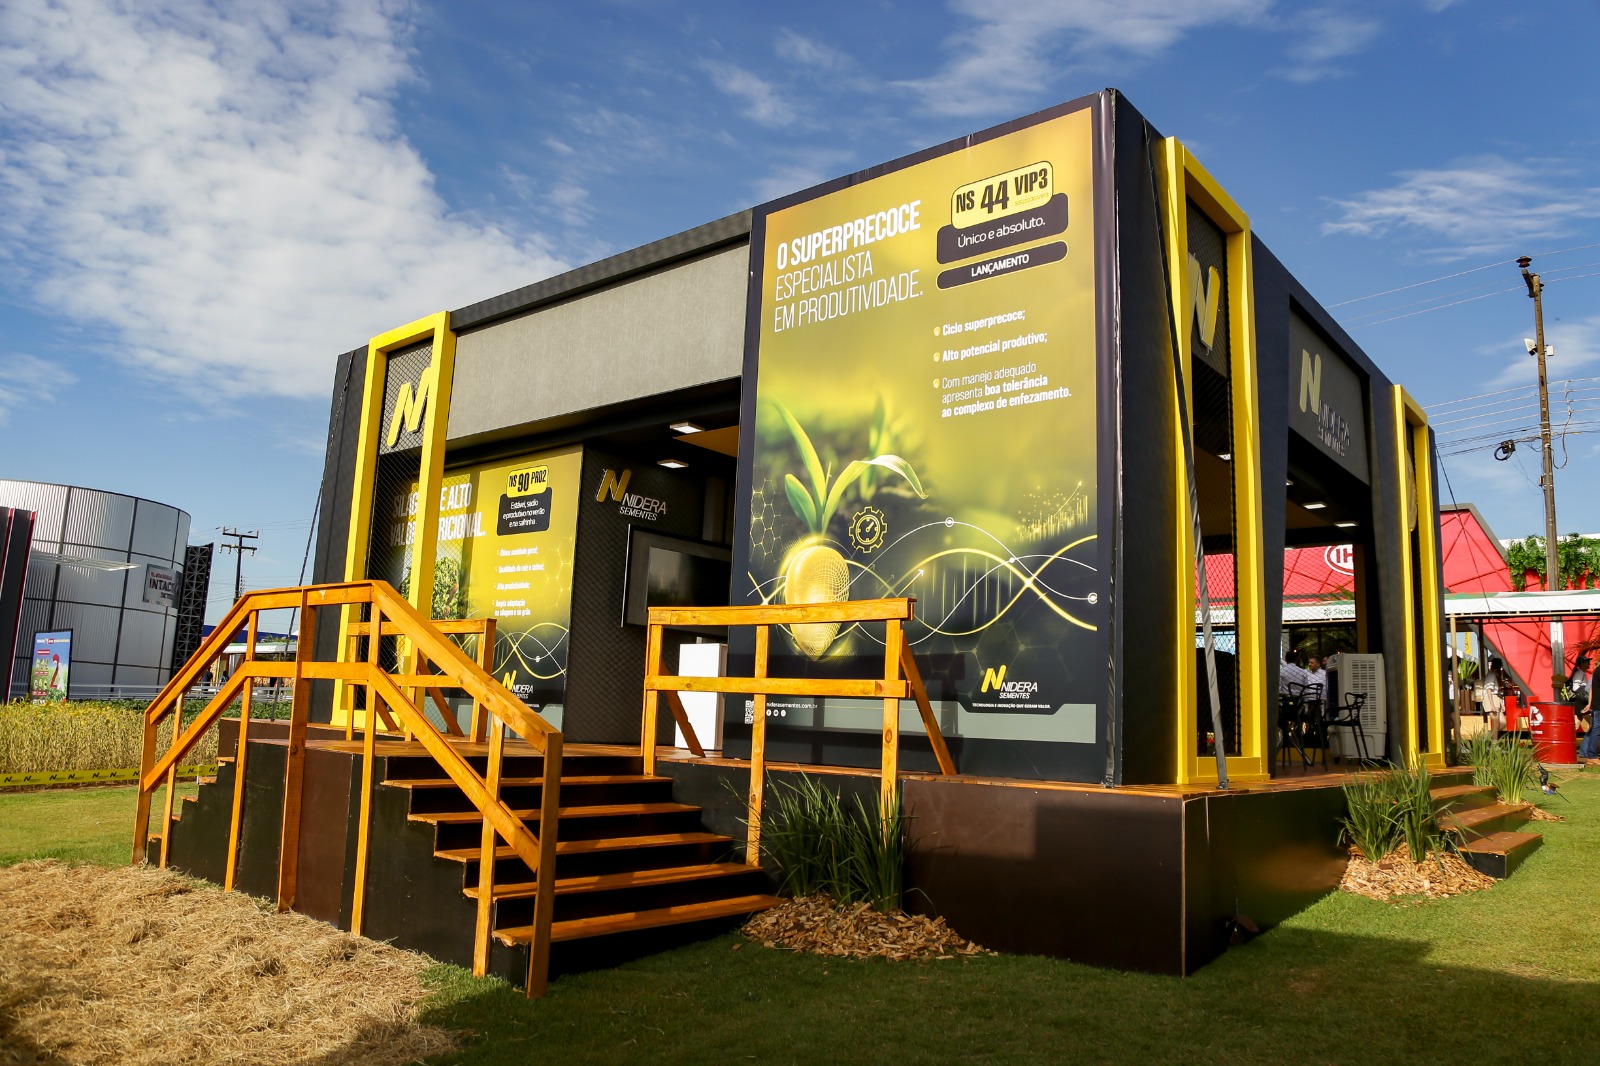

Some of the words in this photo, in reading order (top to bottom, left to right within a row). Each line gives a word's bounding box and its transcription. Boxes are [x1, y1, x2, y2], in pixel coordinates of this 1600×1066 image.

[956, 190, 975, 213] NS
[980, 180, 1009, 214] 44
[1014, 168, 1048, 196] VIP3
[776, 242, 788, 270] O
[790, 200, 921, 266] SUPERPRECOCE
[958, 233, 986, 248] Único
[988, 230, 994, 240] e
[996, 216, 1046, 237] absoluto.
[776, 250, 873, 301] ESPECIALISTA
[971, 254, 1030, 275] LANÇAMENTO
[774, 303, 794, 332] EM
[798, 270, 923, 326] PRODUTIVIDADE.
[942, 322, 962, 336] Ciclo
[964, 310, 1026, 332] superprecoce;
[942, 350, 958, 362] Alto
[960, 340, 1000, 360] potencial
[1002, 332, 1048, 352] produtivo;
[942, 376, 960, 389] Com
[962, 370, 992, 384] manejo
[994, 362, 1036, 379] adequado
[942, 388, 982, 405] apresenta
[984, 384, 1000, 396] boa
[1002, 374, 1048, 392] tolerância
[942, 408, 952, 418] ao
[954, 400, 994, 416] complexo
[996, 397, 1008, 409] de
[1010, 386, 1072, 406] enfezamento.
[509, 474, 518, 488] NS
[518, 472, 530, 492] 90
[530, 470, 547, 484] PRO2
[440, 486, 448, 511] E
[448, 482, 472, 509] ALTO
[622, 492, 666, 514] NIDERA
[620, 506, 658, 521] SEMENTES
[512, 684, 534, 693] NIDERA
[1000, 682, 1038, 692] NIDERA
